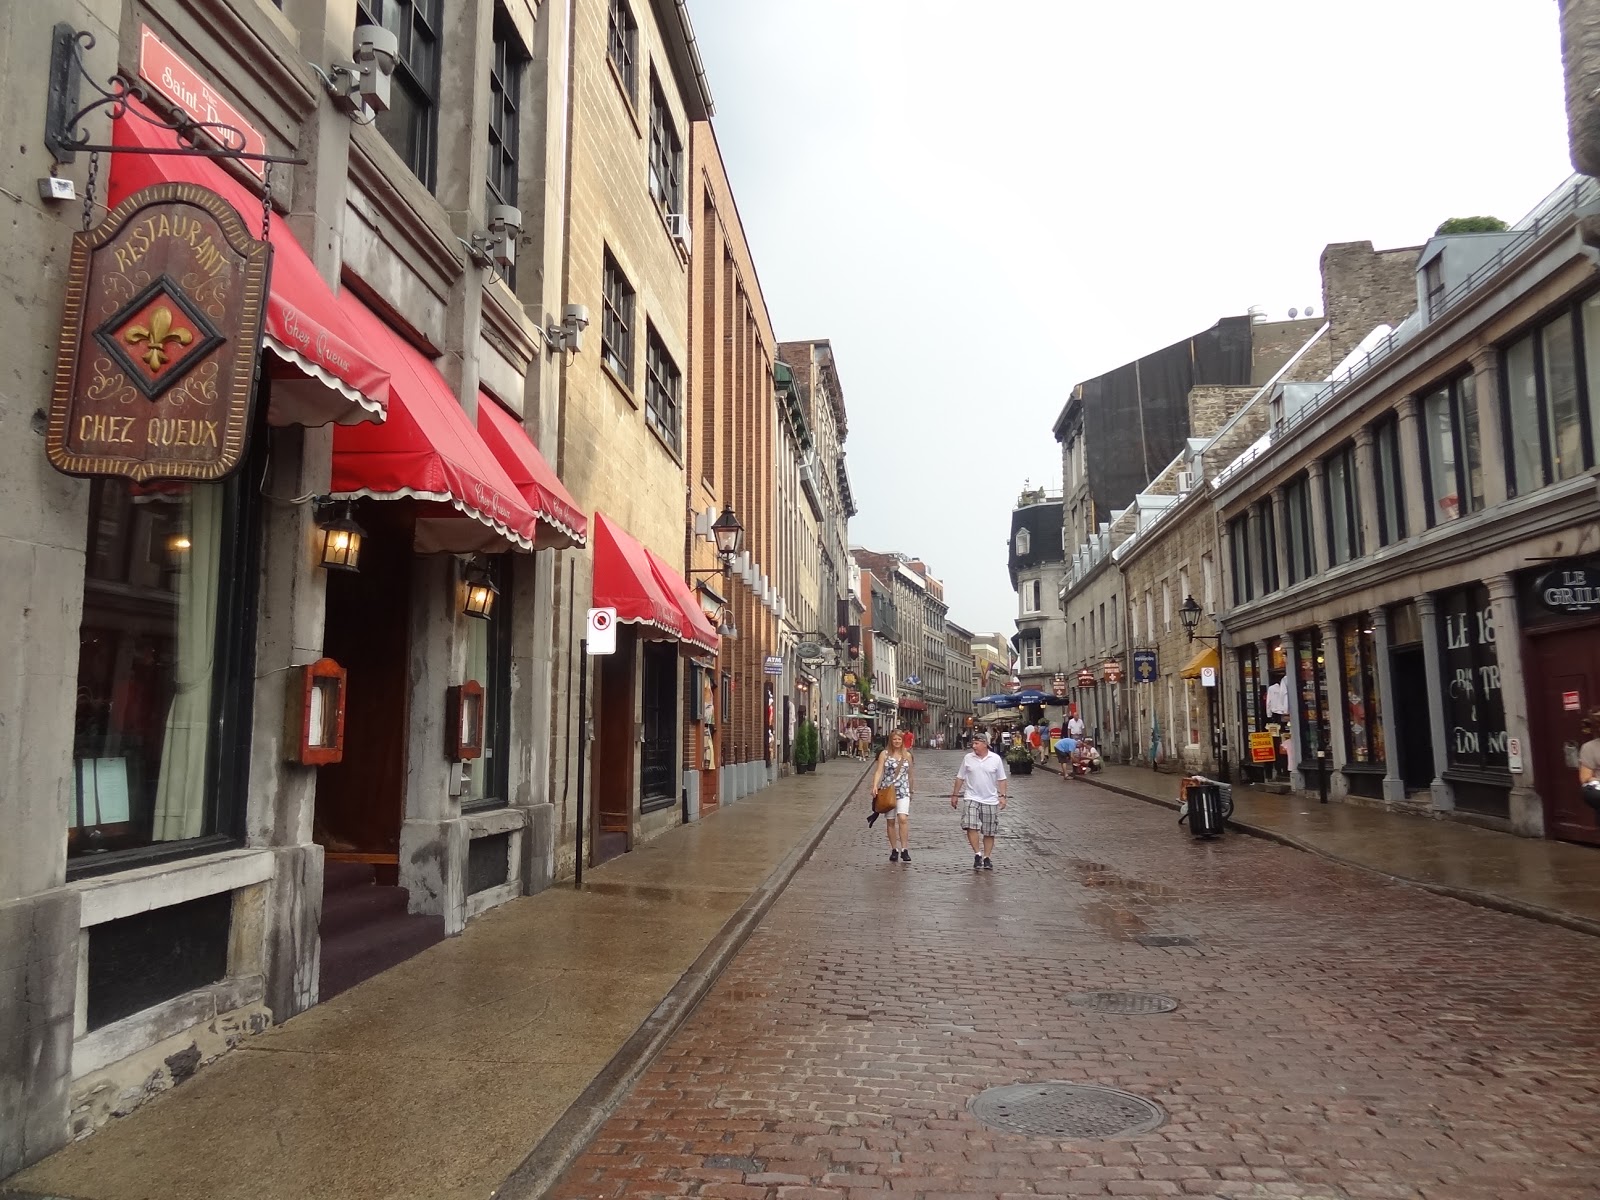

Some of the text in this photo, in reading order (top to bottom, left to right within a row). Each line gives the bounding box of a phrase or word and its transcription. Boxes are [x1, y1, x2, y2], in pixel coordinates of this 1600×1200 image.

[202, 87, 218, 107] Rue
[113, 213, 230, 277] RESTAURANT
[282, 306, 310, 348] Chez
[79, 414, 219, 448] CHEZ QUEUX
[1561, 570, 1587, 586] LE
